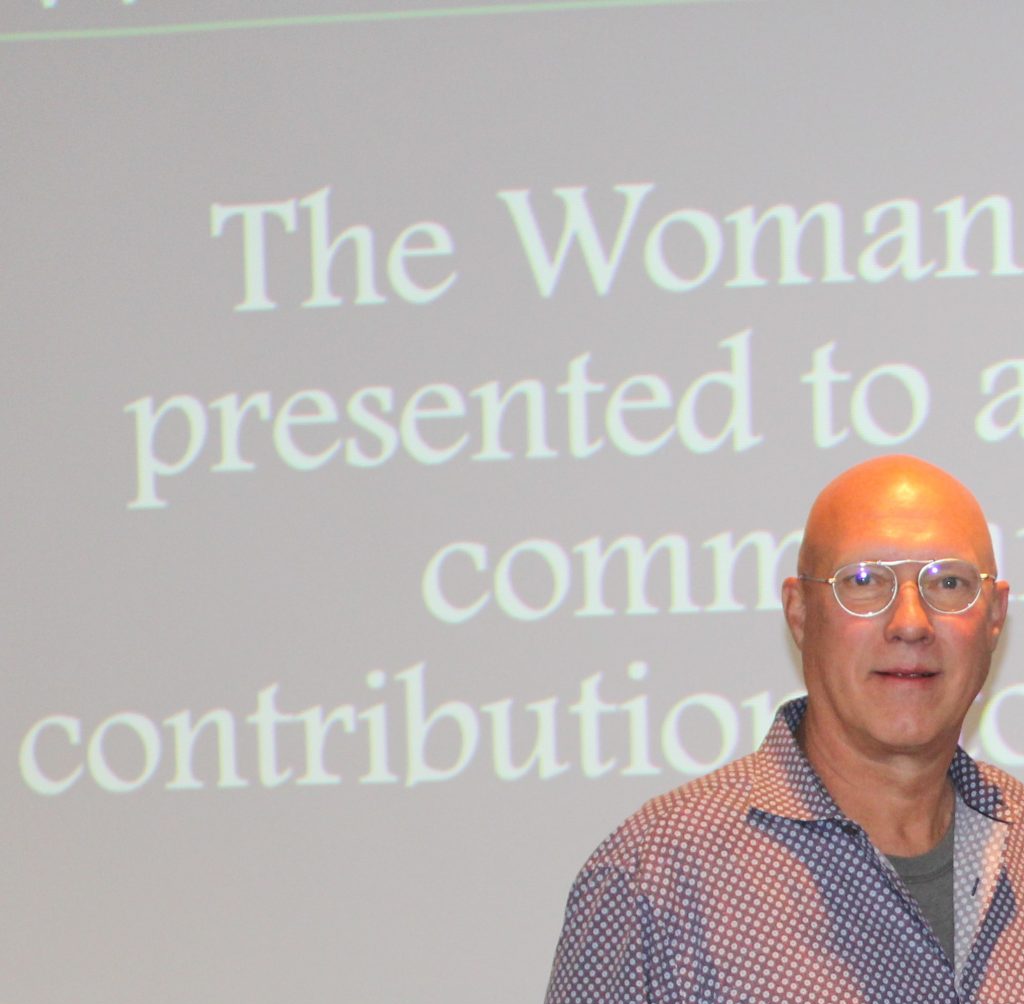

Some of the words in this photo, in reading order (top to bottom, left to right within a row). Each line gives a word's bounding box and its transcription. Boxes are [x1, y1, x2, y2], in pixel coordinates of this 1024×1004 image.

[211, 187, 456, 311] The
[124, 329, 763, 509] presented
[801, 341, 930, 449] to
[19, 661, 808, 795] contributio
